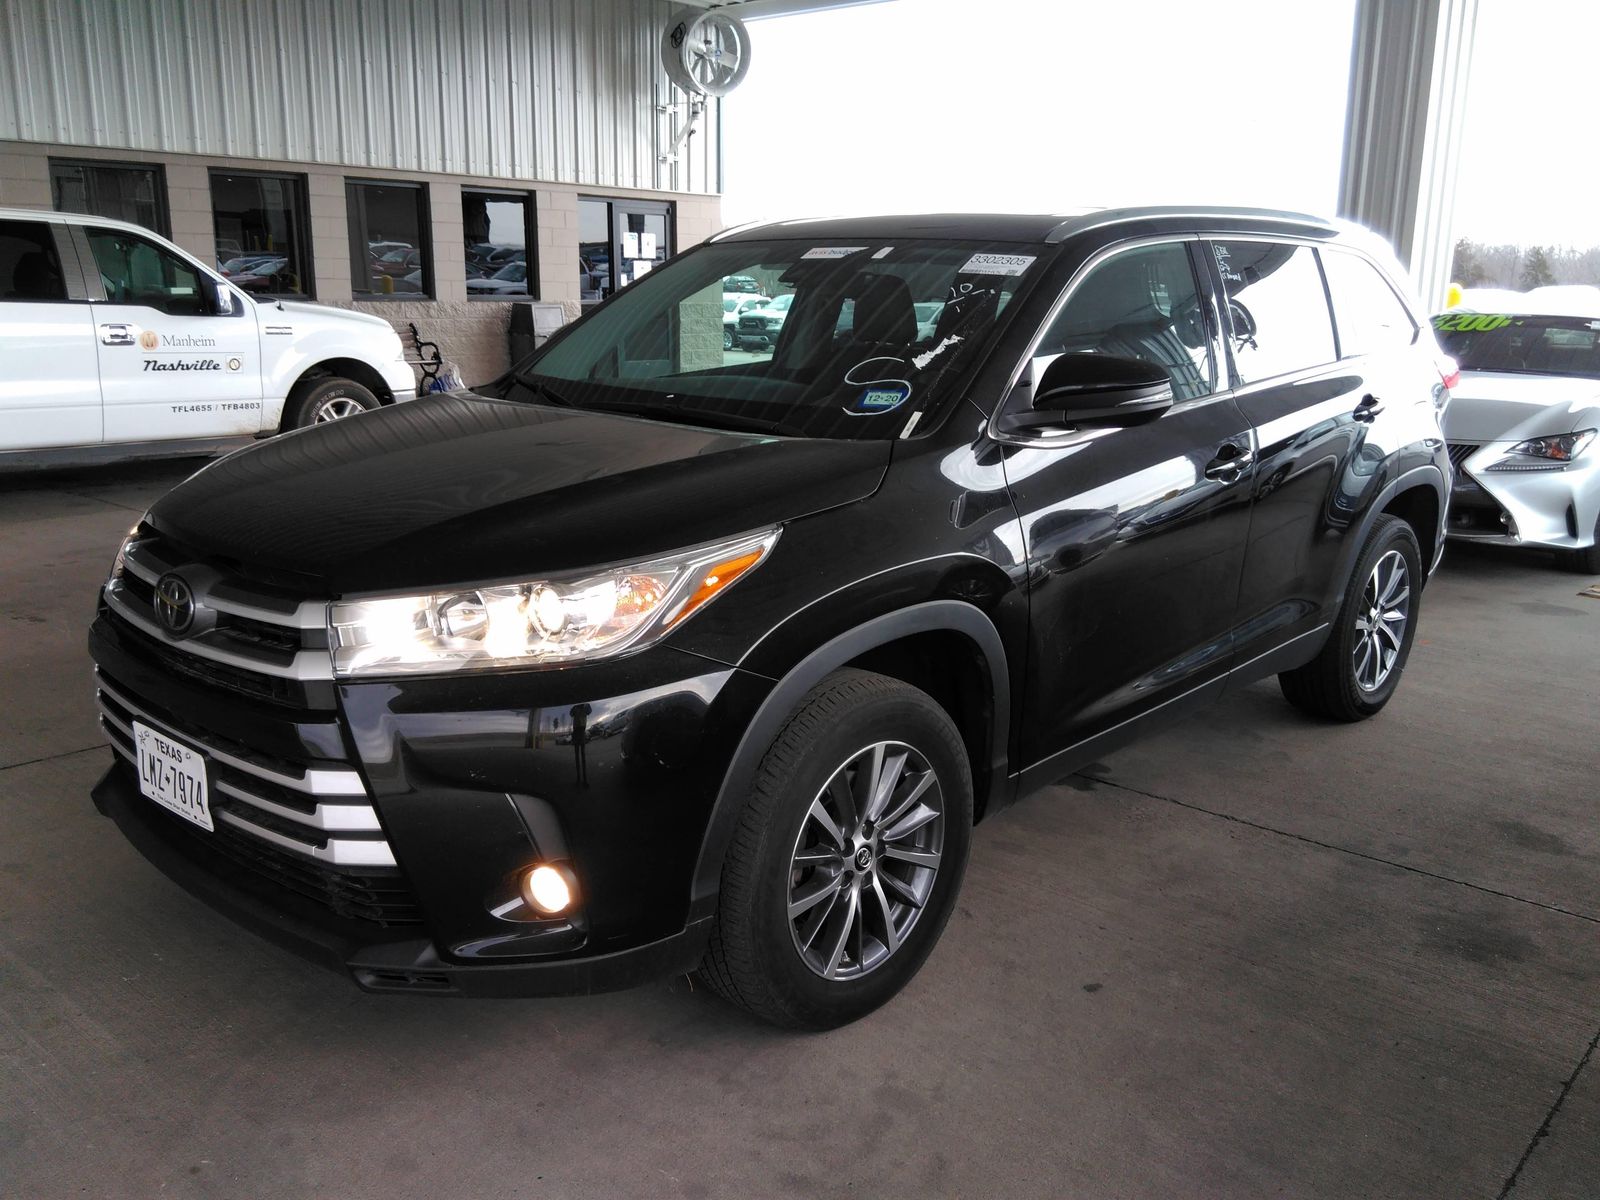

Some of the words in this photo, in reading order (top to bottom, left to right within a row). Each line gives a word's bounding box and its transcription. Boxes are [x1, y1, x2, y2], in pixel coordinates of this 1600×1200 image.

[970, 255, 1026, 266] 3302305
[161, 334, 216, 347] Manheim
[143, 359, 222, 372] Nashville
[171, 405, 213, 413] TFL4655
[221, 402, 260, 411] TFB4803
[154, 737, 182, 763] TEXAS
